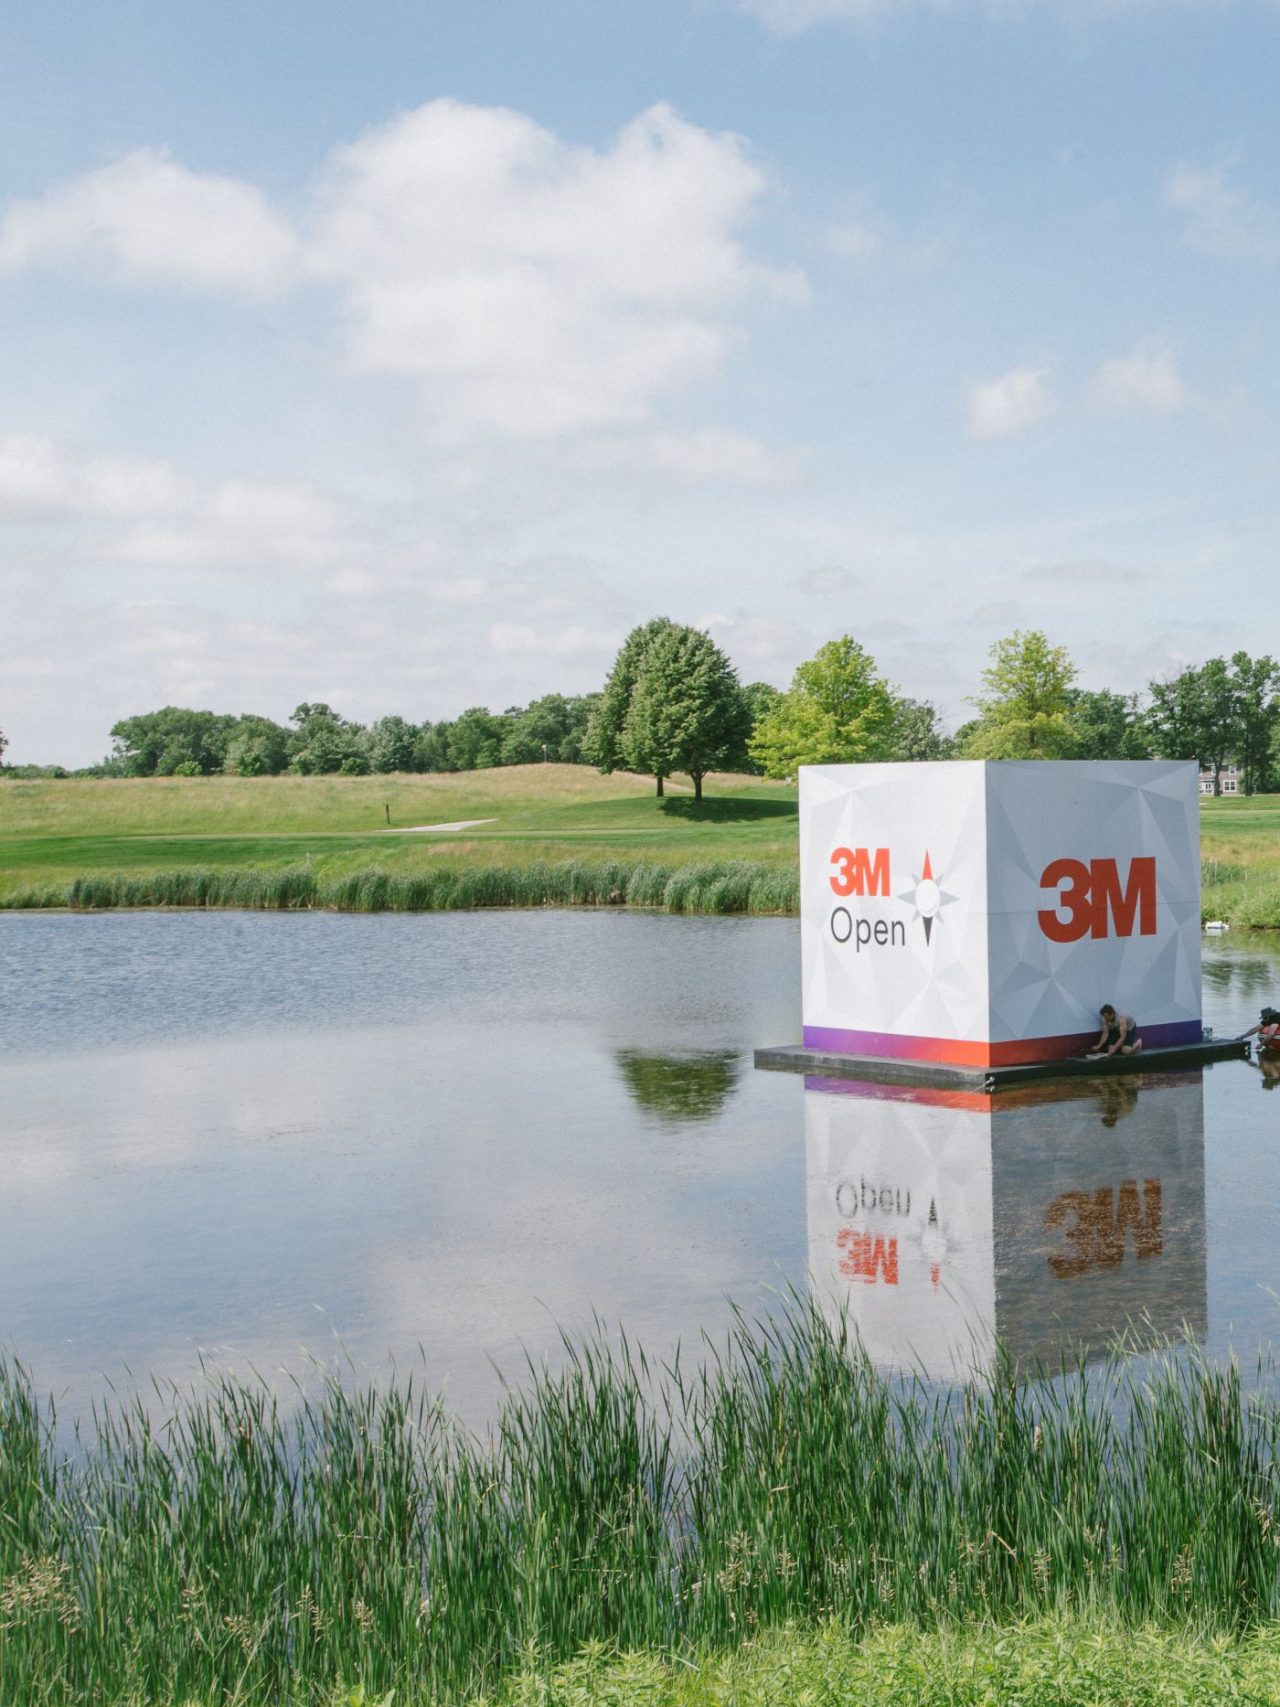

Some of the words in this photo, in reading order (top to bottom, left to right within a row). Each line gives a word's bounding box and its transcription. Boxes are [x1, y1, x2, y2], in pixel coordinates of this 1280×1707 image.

[829, 847, 891, 897] 3M
[1037, 856, 1157, 943] 3M
[831, 906, 905, 953] Open
